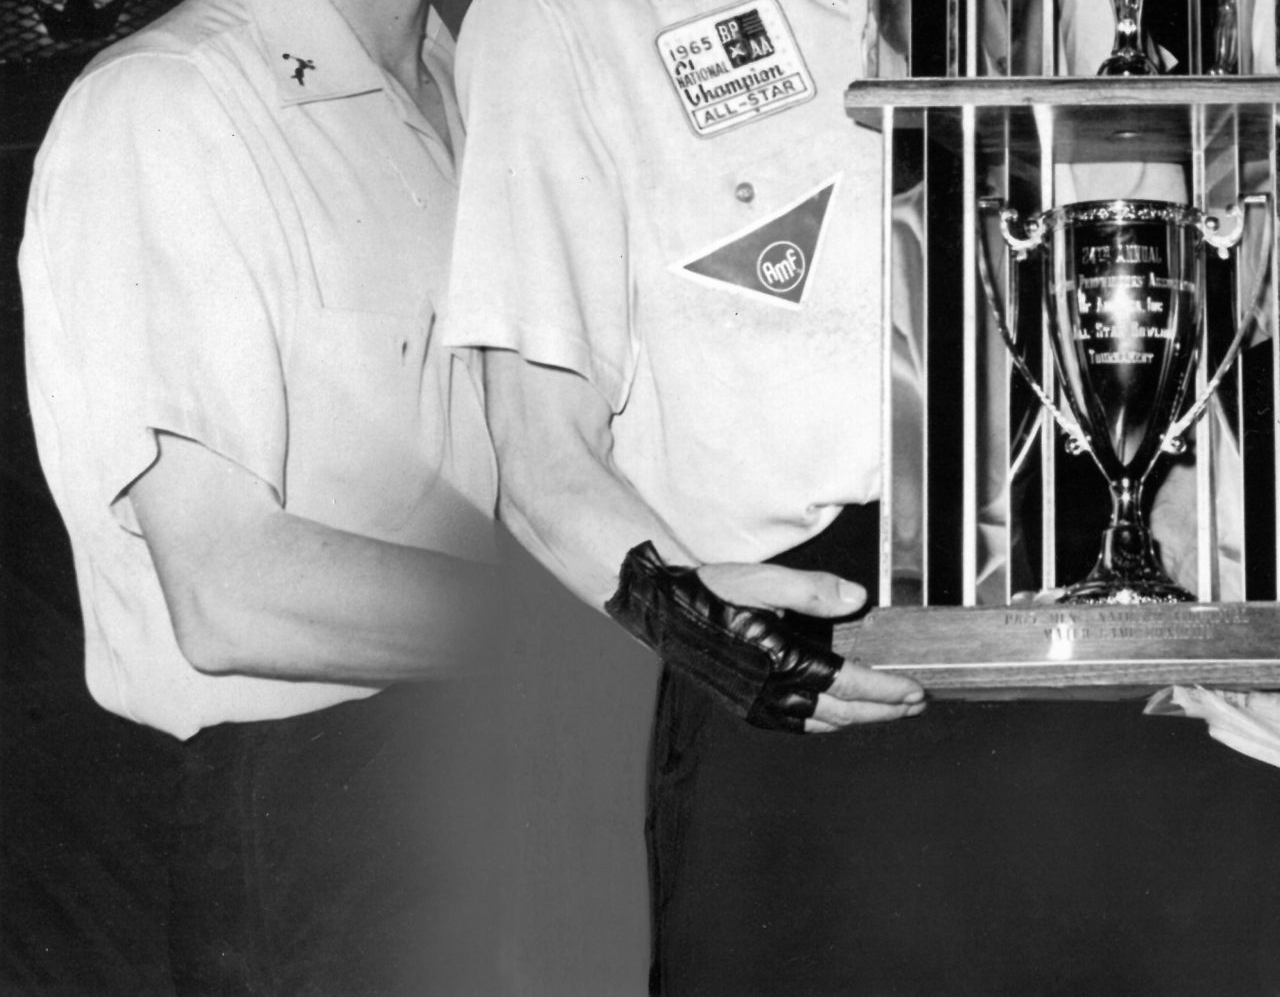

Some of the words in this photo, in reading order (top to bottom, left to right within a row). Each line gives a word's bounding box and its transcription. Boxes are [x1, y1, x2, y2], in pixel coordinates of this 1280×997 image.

[718, 19, 739, 44] BP
[668, 36, 714, 62] 1965
[749, 35, 774, 59] AA
[676, 61, 730, 89] NATIONAL
[703, 79, 797, 124] ALL-STAR
